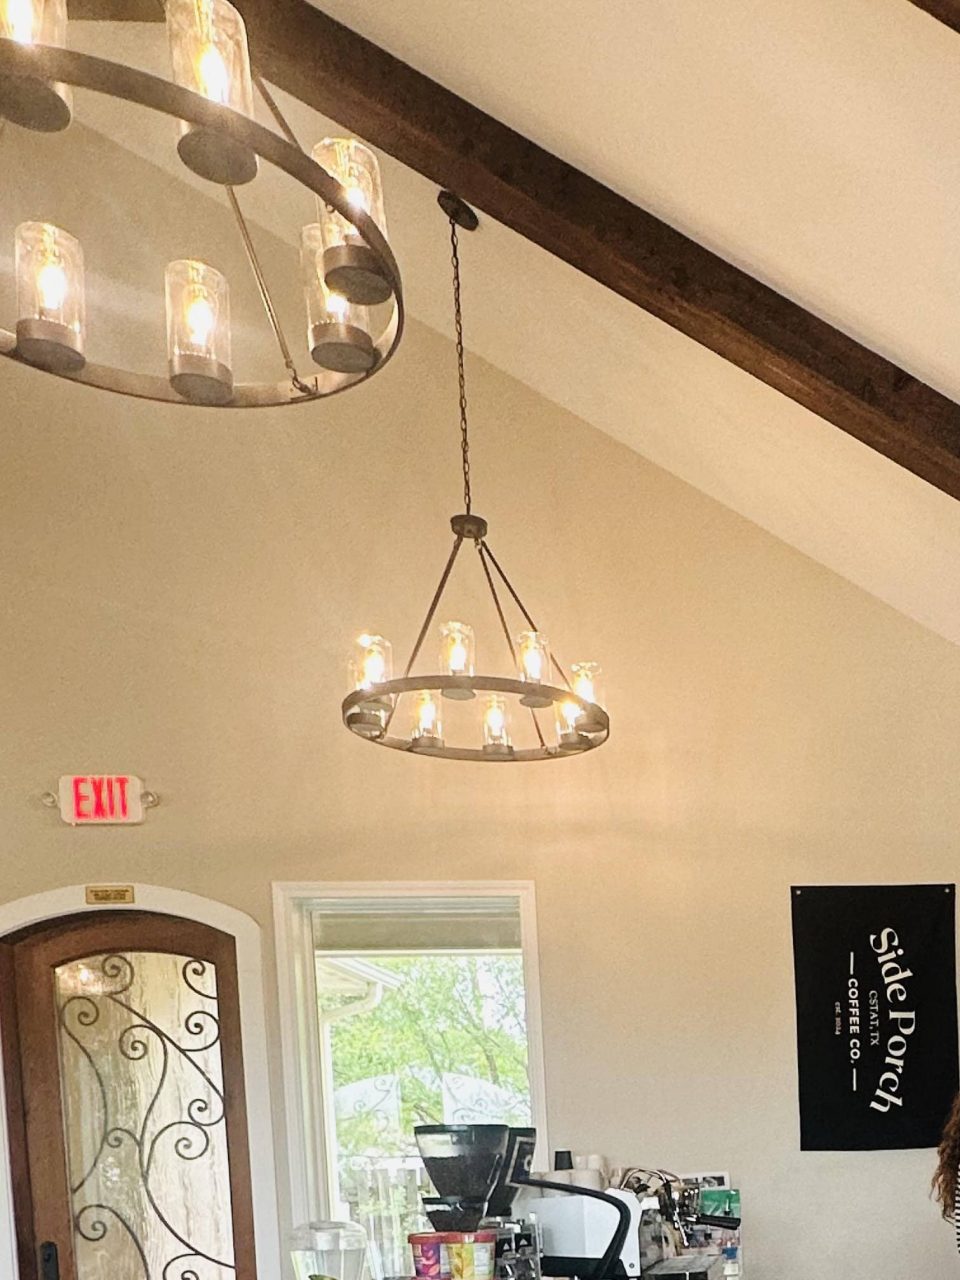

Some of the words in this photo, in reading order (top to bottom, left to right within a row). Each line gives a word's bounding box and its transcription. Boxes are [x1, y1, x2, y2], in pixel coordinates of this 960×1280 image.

[72, 776, 129, 820] EXIT
[869, 927, 914, 1004] Side
[848, 978, 860, 1034] COFFEE
[849, 1038, 861, 1064] CO.
[869, 1009, 916, 1113] Porch
[870, 1030, 880, 1046] TX
